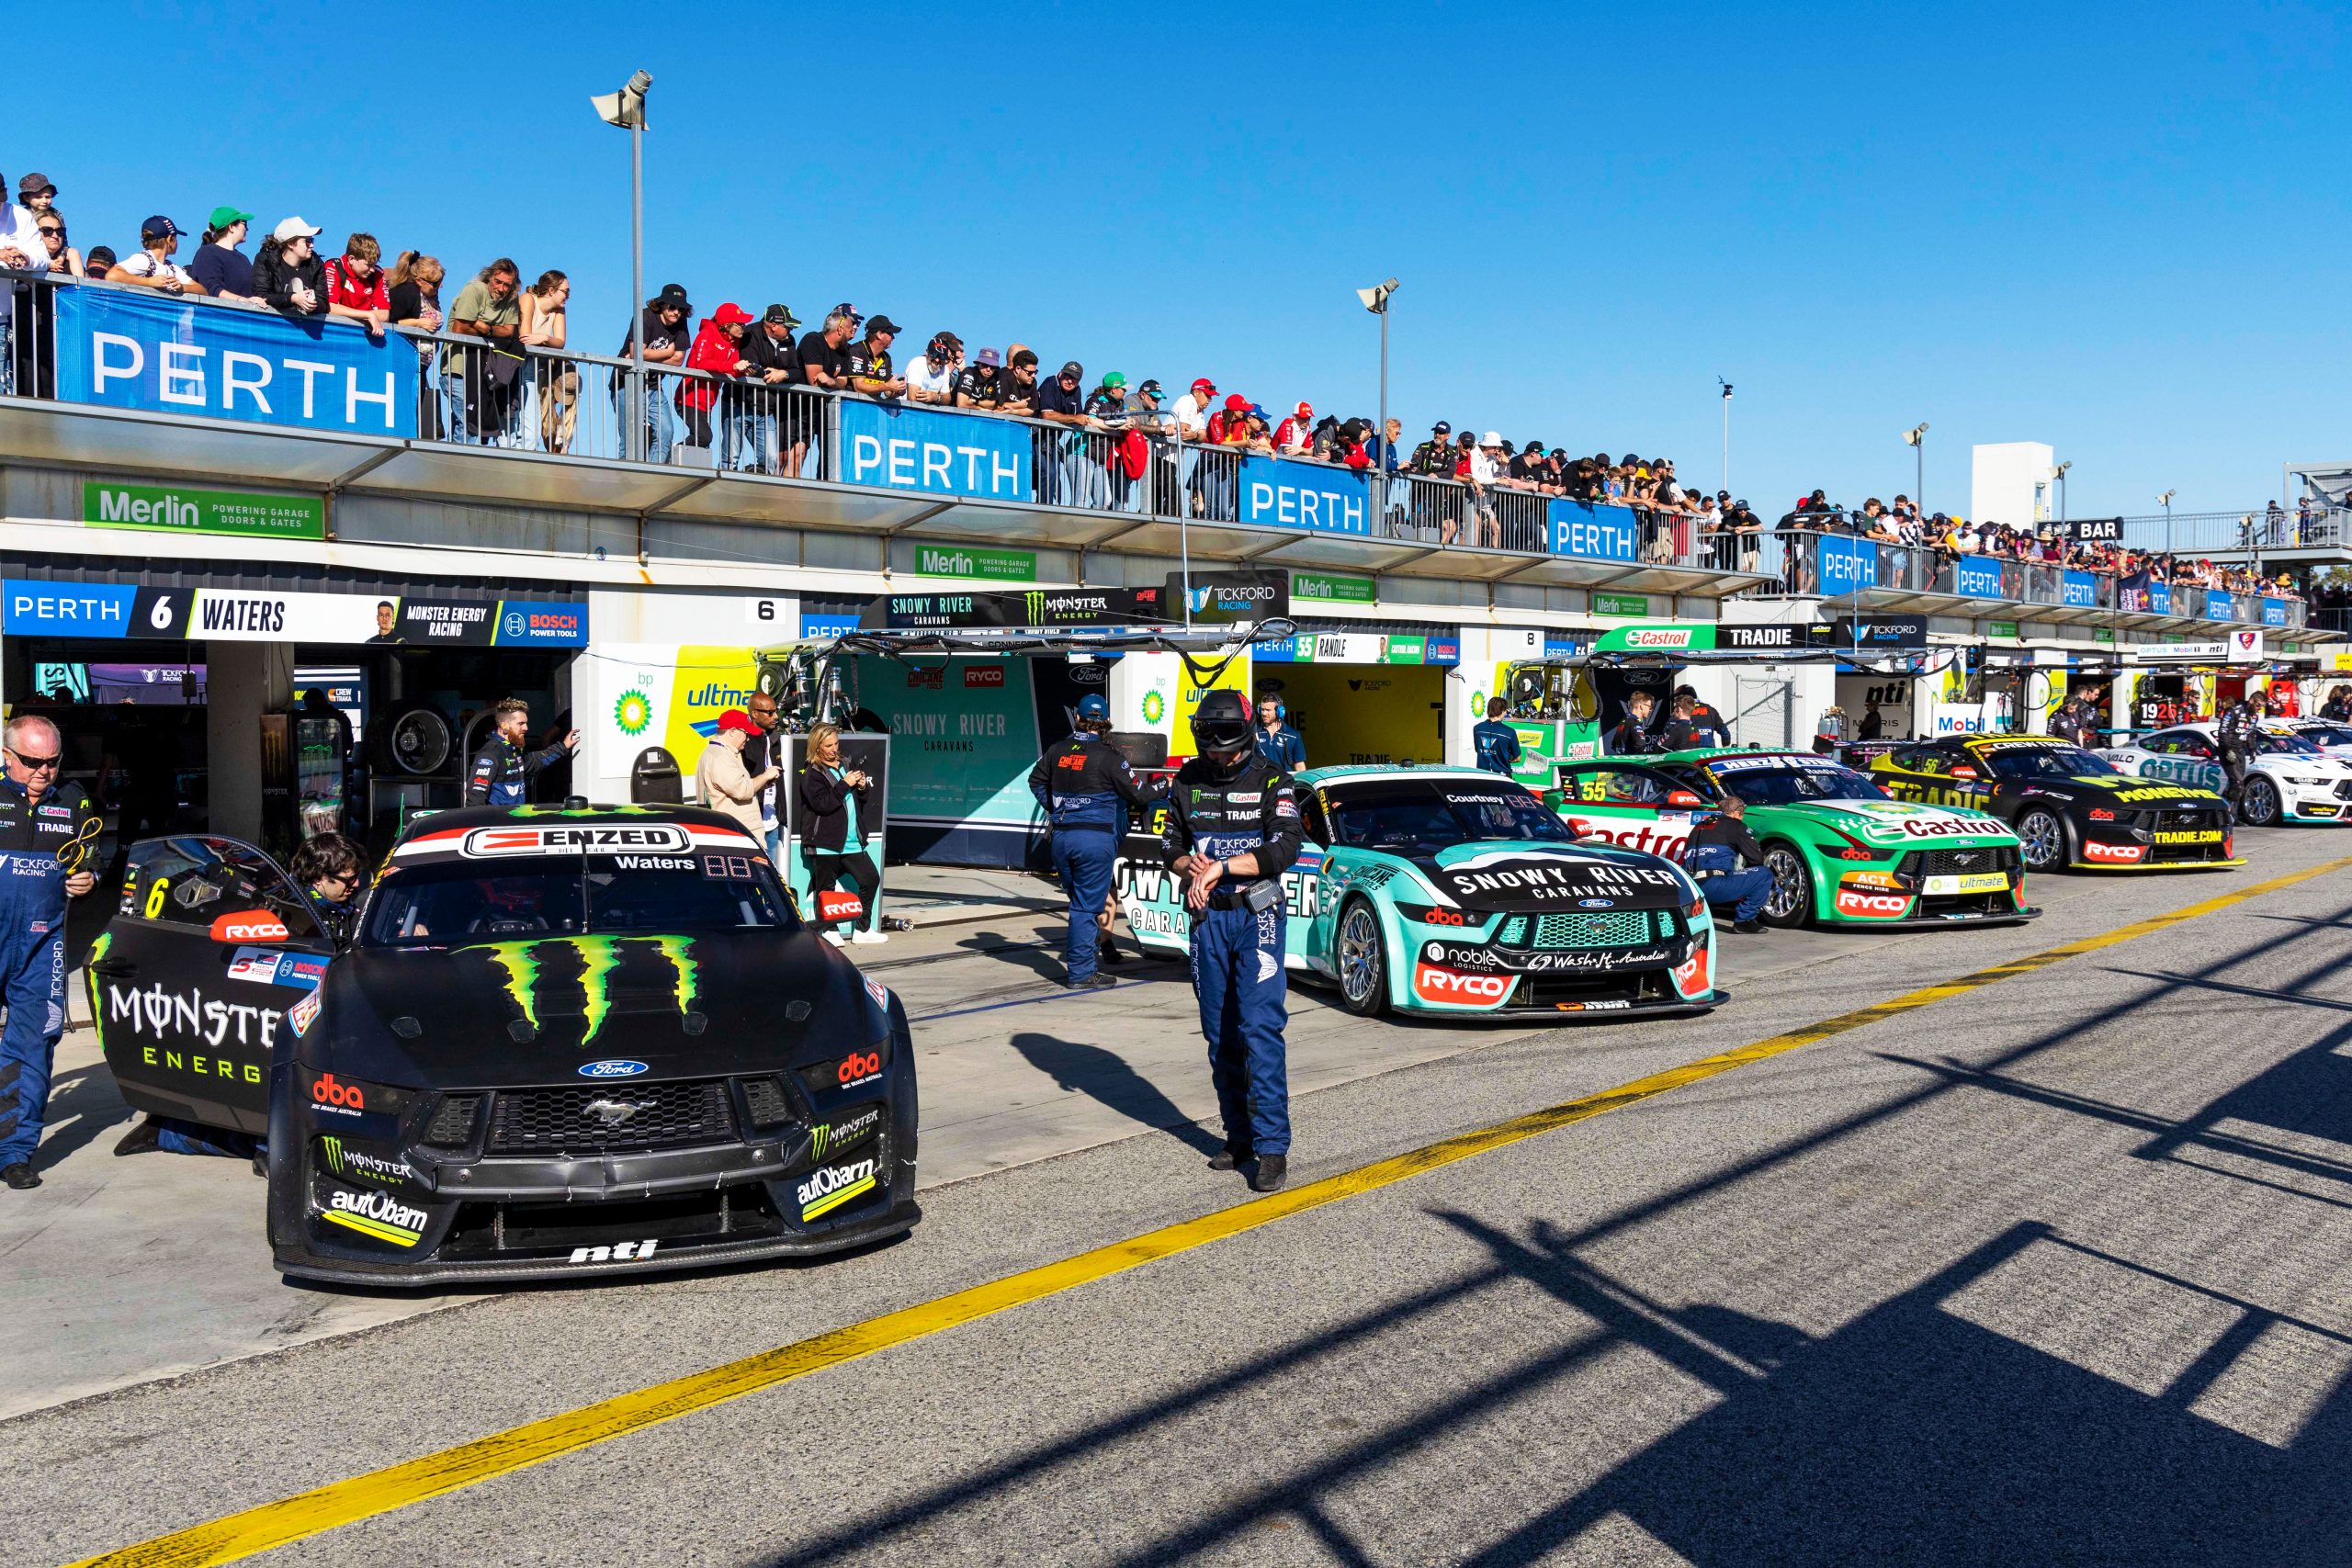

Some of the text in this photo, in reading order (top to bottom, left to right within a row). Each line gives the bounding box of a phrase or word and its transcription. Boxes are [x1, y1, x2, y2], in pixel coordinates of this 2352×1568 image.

[93, 331, 395, 428] PERTH
[854, 435, 1018, 495] PERTH
[100, 491, 199, 525] Merlin
[212, 504, 311, 519] POWERING GARAGE
[1251, 482, 1363, 532] PERTH
[221, 514, 302, 528] DOORS & GATES
[2081, 523, 2116, 538] BAR
[1557, 521, 1632, 557] PERTH
[922, 550, 973, 574] Merlin
[978, 558, 1029, 568] POWERING GARAGE
[983, 565, 1001, 573] DOORS
[1008, 566, 1025, 574] GATES
[1826, 553, 1874, 582] PERTH
[1298, 579, 1331, 597] Merlin
[1961, 570, 1997, 596] PERTH
[1215, 586, 1275, 601] TICKFORD
[2064, 582, 2093, 604] PERTH
[15, 596, 120, 622] PERTH
[758, 600, 775, 621] 6
[893, 597, 972, 614] SNOWY RIVER
[1046, 596, 1107, 612] MONSTER
[1218, 601, 1251, 610] RACING
[1597, 598, 1619, 613] Merlin
[2210, 601, 2231, 620] PERTH
[151, 595, 173, 629] 6
[202, 598, 285, 633] WATERS
[407, 605, 487, 624] MONSTER ENERGY
[529, 614, 578, 628] BOSCH
[914, 616, 950, 626] CARAVANS
[429, 621, 463, 637] RACING
[530, 628, 578, 637] POWER TOOLS
[1872, 625, 1917, 635] TICKFORD
[1527, 632, 1534, 645] 8
[1641, 632, 1688, 646] Castrol
[1731, 629, 1792, 646] TRADIE
[1256, 639, 1293, 652] PERTH
[1297, 637, 1313, 657] 55
[1318, 638, 1346, 658] RANDLE
[1438, 645, 1456, 653] BOSCH
[2209, 644, 2223, 653] nti
[638, 671, 653, 687] bp
[966, 671, 1001, 682] RYCO
[1078, 664, 1104, 681] Ford
[1156, 676, 1166, 687] bp
[335, 688, 352, 696] CREW
[687, 683, 756, 706] ultima
[1865, 681, 1906, 704] nti
[893, 713, 1006, 736] SNOWY RIVER
[1939, 717, 1985, 731] Mobil
[924, 740, 975, 752] CARAVANS
[1574, 745, 1593, 756] Castrol
[1993, 741, 2037, 750] CREW
[1924, 758, 1939, 773] 56
[2107, 753, 2134, 763] VALO
[476, 768, 491, 776] nti
[1804, 767, 1838, 776] Randle
[2139, 758, 2222, 794] OPTUS
[1235, 793, 1260, 803] Castrol
[1582, 781, 1607, 801] 55
[1888, 781, 1991, 814] TRADIE
[2114, 787, 2222, 803] MONEYME
[1446, 794, 1504, 805] Courtney
[47, 807, 70, 817] Castrol
[1227, 809, 1261, 820] TRADIE
[2089, 808, 2115, 819] dba
[38, 822, 74, 834] TRADIE
[1153, 809, 1167, 834] 5
[1904, 818, 2012, 837] Castrol
[543, 829, 672, 847] ENZED
[1213, 838, 1261, 850] TICKFORD
[2154, 830, 2222, 844] TRADIE.COM
[1216, 849, 1245, 857] RACING
[1841, 848, 1871, 861] dba
[2086, 843, 2141, 858] RYCO
[10, 857, 62, 870] TICKFORD
[615, 855, 695, 871] Waters
[1297, 856, 1320, 864] BOSCH
[13, 868, 46, 876] RACING
[1857, 873, 1889, 885] ACT
[1453, 866, 1681, 895] SNOWY RIVER
[1960, 875, 2004, 889] ultimate
[144, 878, 169, 919] 6
[1532, 886, 1634, 899] CARAVANS
[824, 901, 863, 916] RYCO
[1586, 899, 1608, 908] Ford
[1839, 893, 1905, 911] RYCO
[1425, 906, 1463, 926] dba
[225, 924, 288, 940] RYCO
[1259, 910, 1268, 947] TICKFO
[1449, 949, 1498, 965] noble
[1620, 950, 1665, 963] Australia
[51, 941, 63, 998] TICKFORD
[294, 962, 324, 974] BOSCH
[1453, 962, 1493, 972] LOGISTICS
[1422, 970, 1504, 997] RYCO
[108, 983, 280, 1048] MONSTE
[143, 1046, 261, 1084] ENERG
[593, 1062, 633, 1075] Ford
[839, 1053, 879, 1083] dba
[851, 1077, 865, 1088] BRAKES
[865, 1073, 882, 1083] AUSTRALIA
[313, 1072, 364, 1109] dba
[321, 1105, 338, 1114] BRAKES
[338, 1108, 362, 1117] AUSTRALIA
[830, 1110, 878, 1143] MONSTER
[835, 1126, 870, 1147] ENERGY
[344, 1150, 412, 1179] MONSTER
[356, 1168, 404, 1185] ENERGY
[570, 1239, 658, 1263] nti
